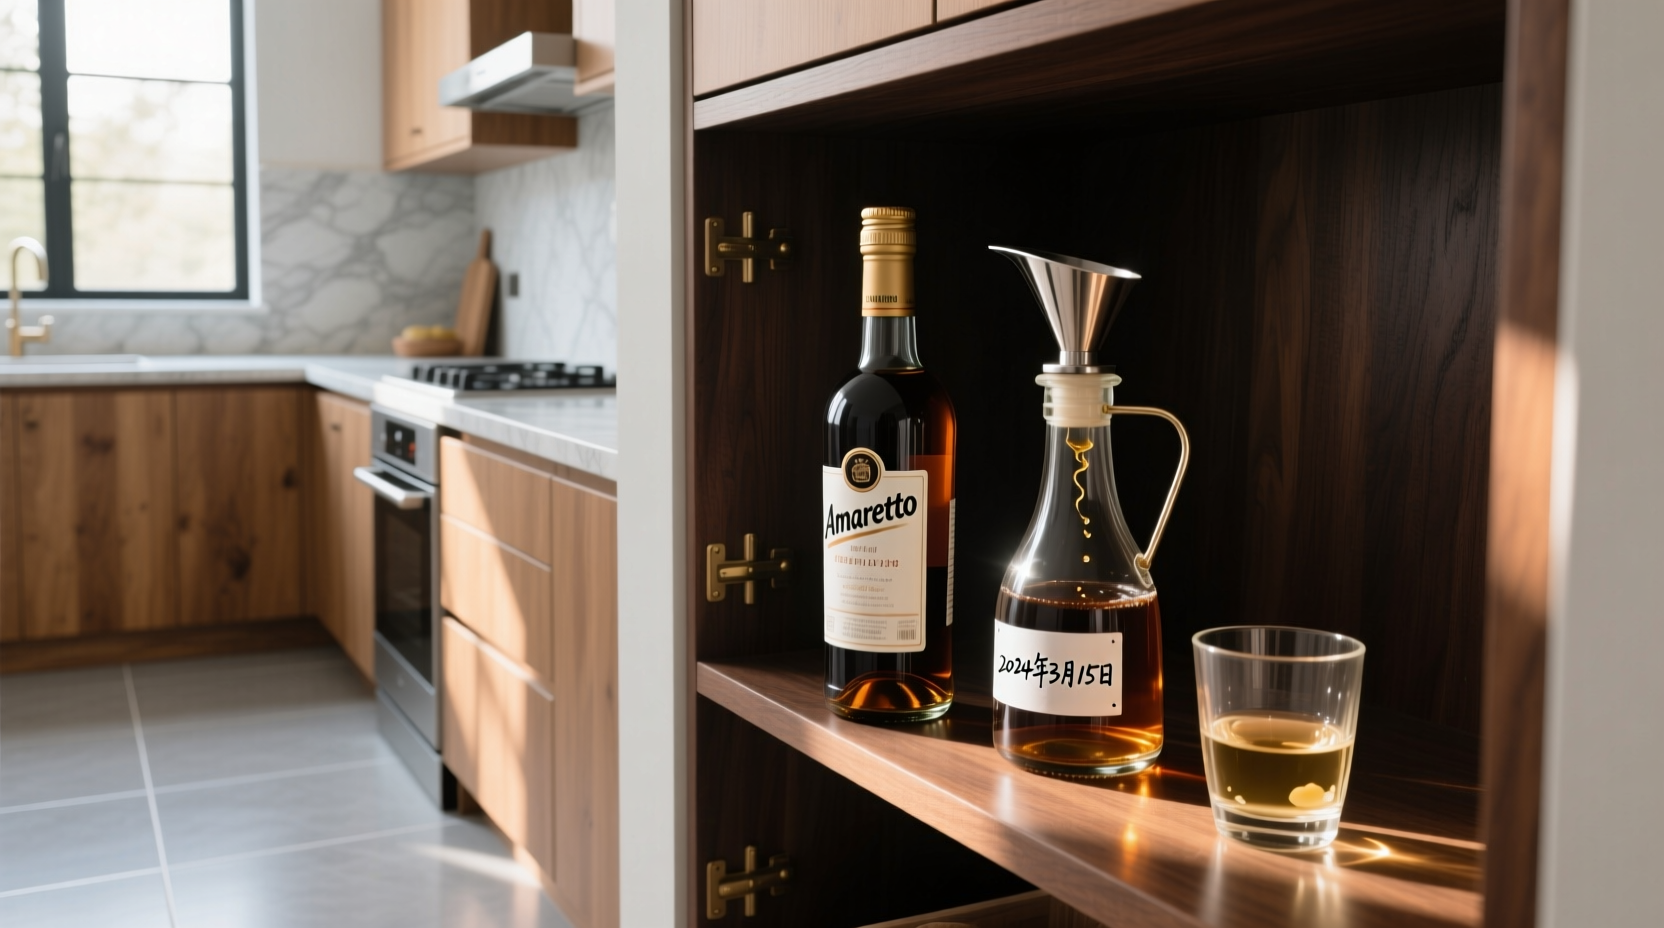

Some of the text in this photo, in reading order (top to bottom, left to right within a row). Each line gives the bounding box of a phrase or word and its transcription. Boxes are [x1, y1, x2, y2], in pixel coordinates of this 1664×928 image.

[825, 492, 917, 539] Amaretto
[998, 652, 1112, 689] 2024年3月15日
